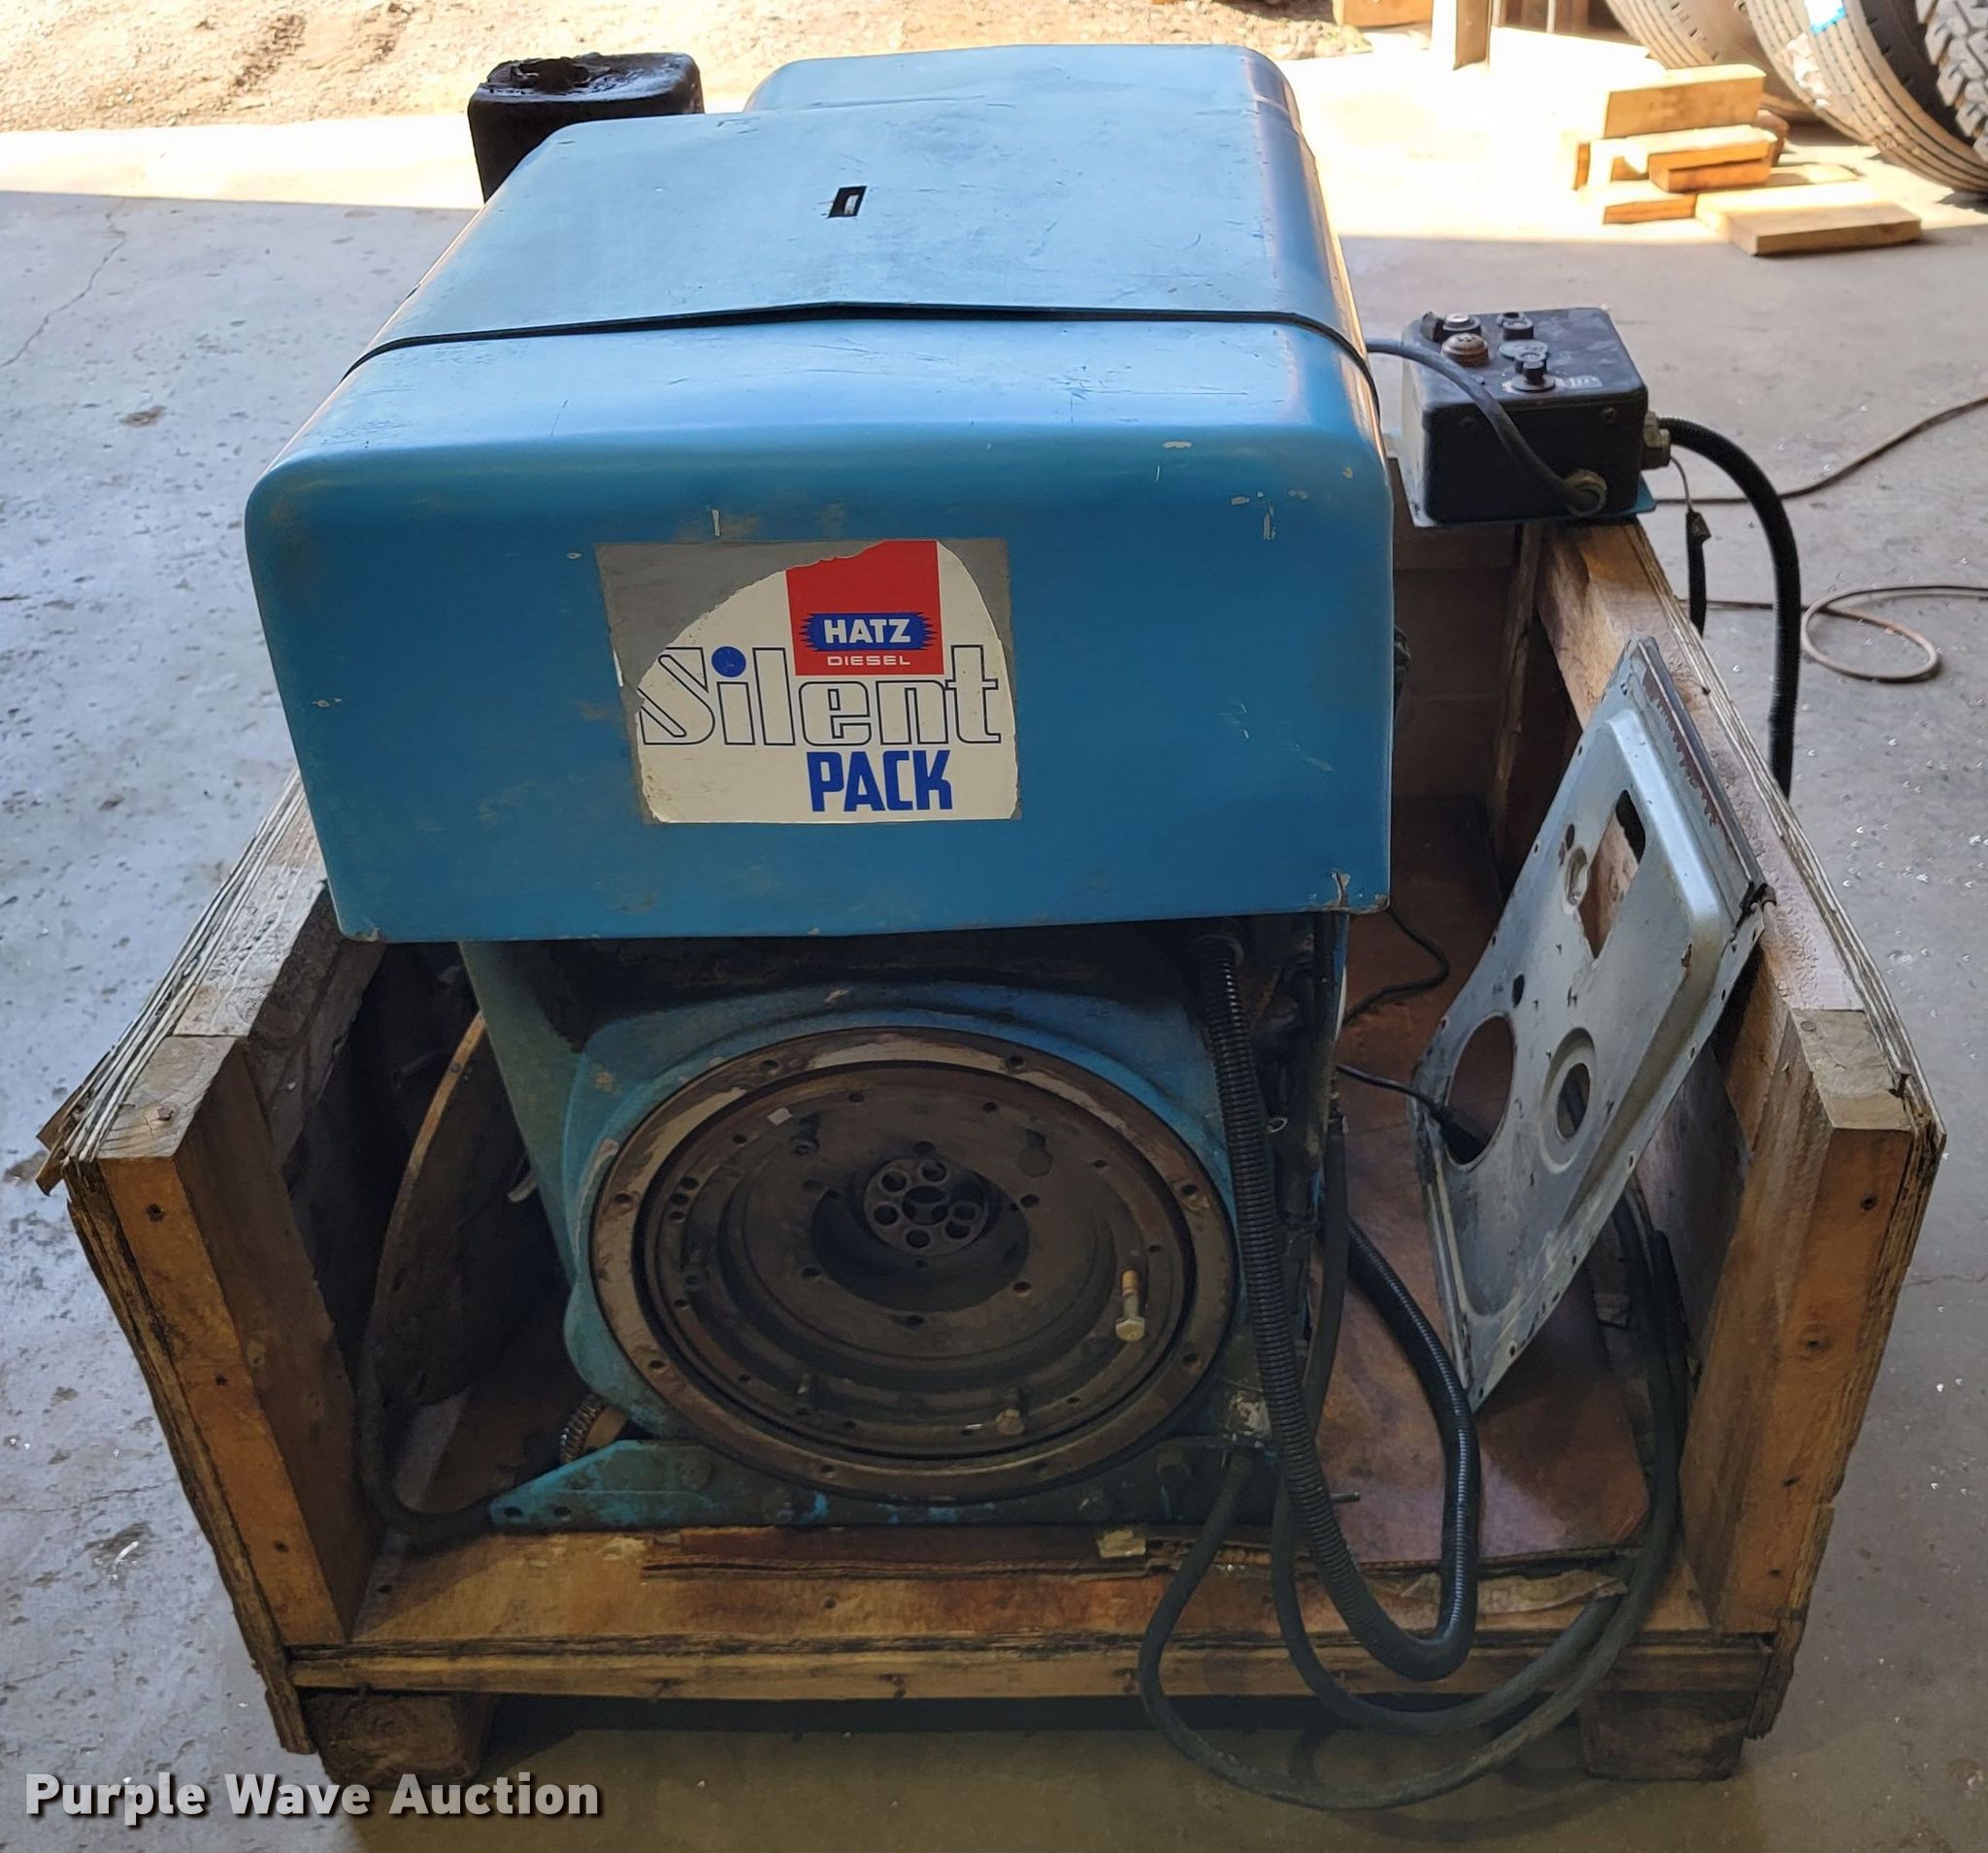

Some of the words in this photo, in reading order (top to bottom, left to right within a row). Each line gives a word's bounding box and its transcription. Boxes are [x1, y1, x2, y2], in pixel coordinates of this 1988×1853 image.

[823, 618, 911, 645] HATZ
[827, 655, 911, 667] DIESEL
[637, 645, 1002, 746] Silent
[806, 749, 953, 812] PACK
